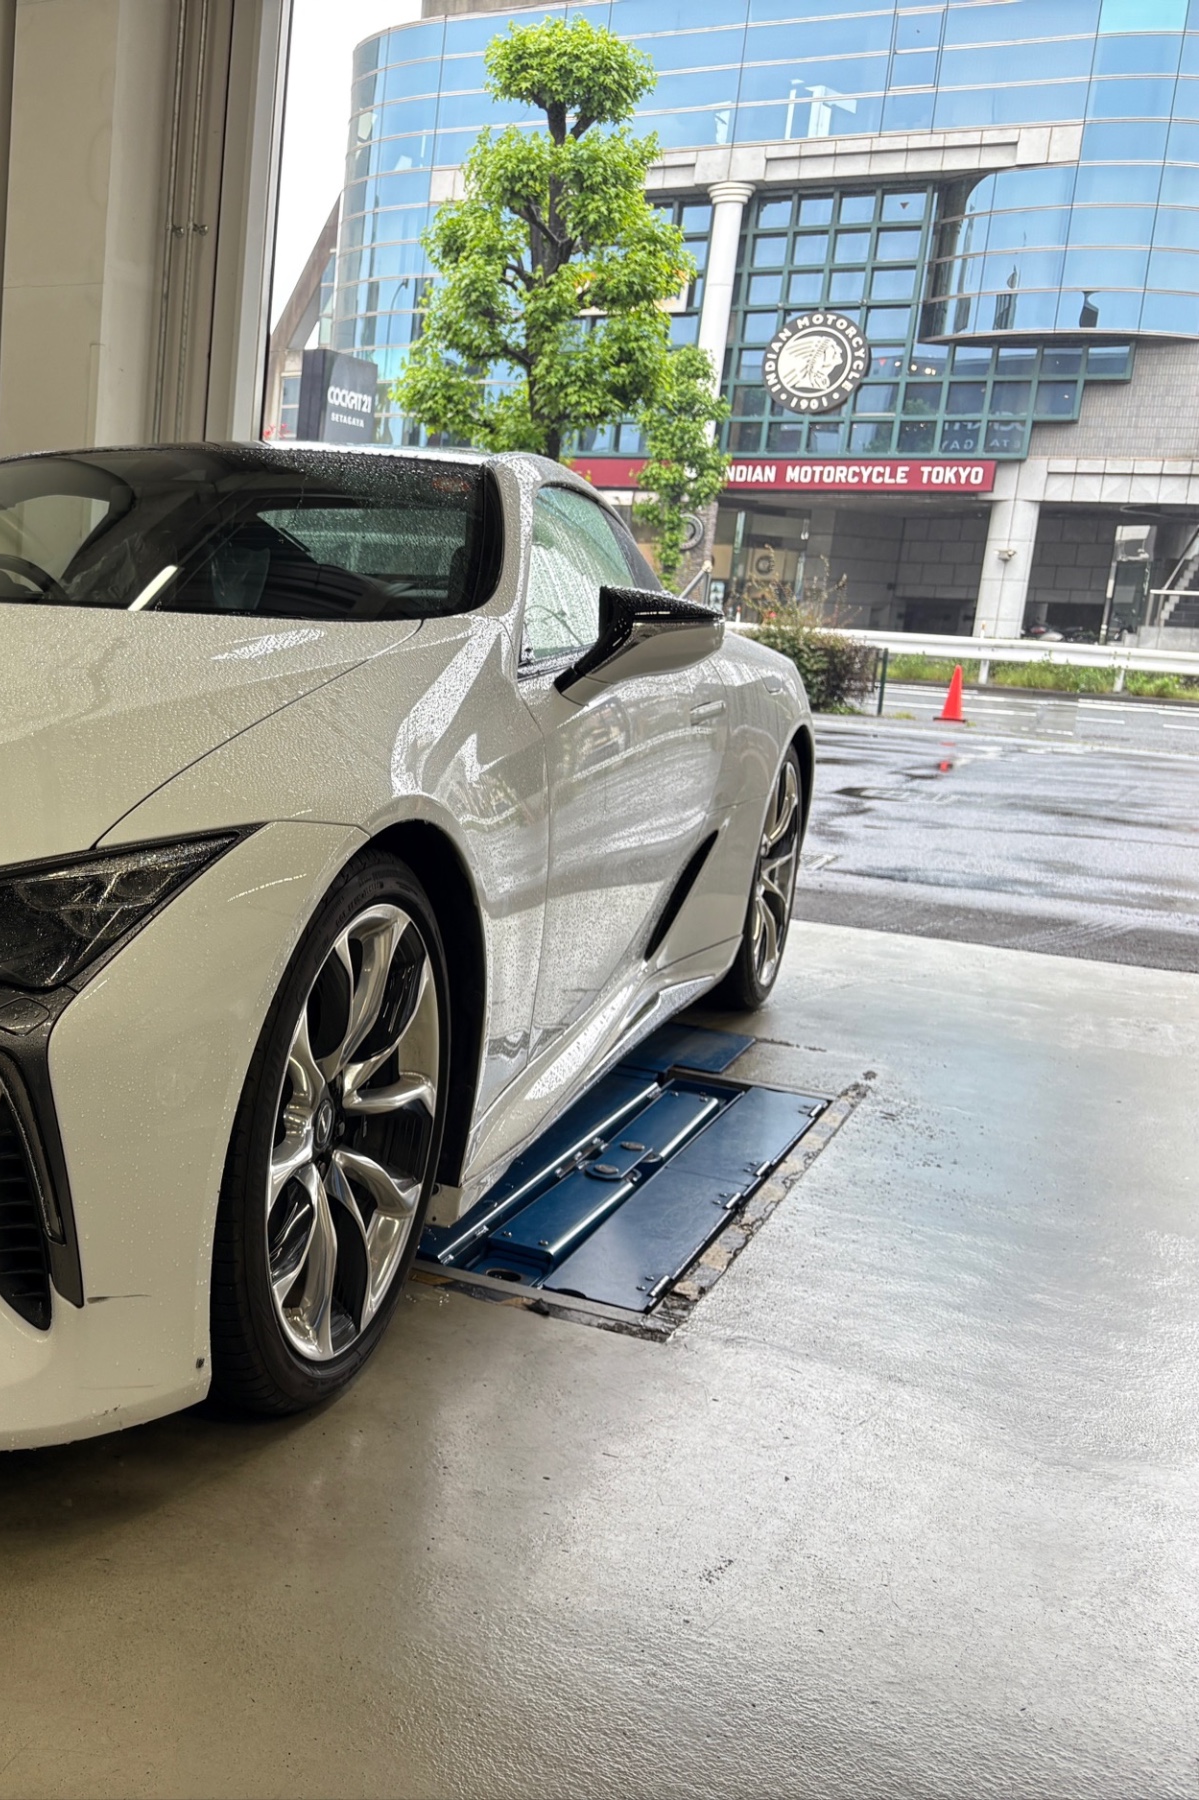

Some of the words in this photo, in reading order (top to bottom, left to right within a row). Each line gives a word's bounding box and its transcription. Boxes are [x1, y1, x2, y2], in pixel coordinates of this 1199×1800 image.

[765, 328, 792, 393] INDIAN
[796, 314, 866, 392] MOTORCYCLE
[790, 397, 828, 410] 1901
[331, 412, 364, 428] SETAGAYA
[785, 465, 909, 484] MOTORCYCLE
[920, 466, 984, 485] TOKYO
